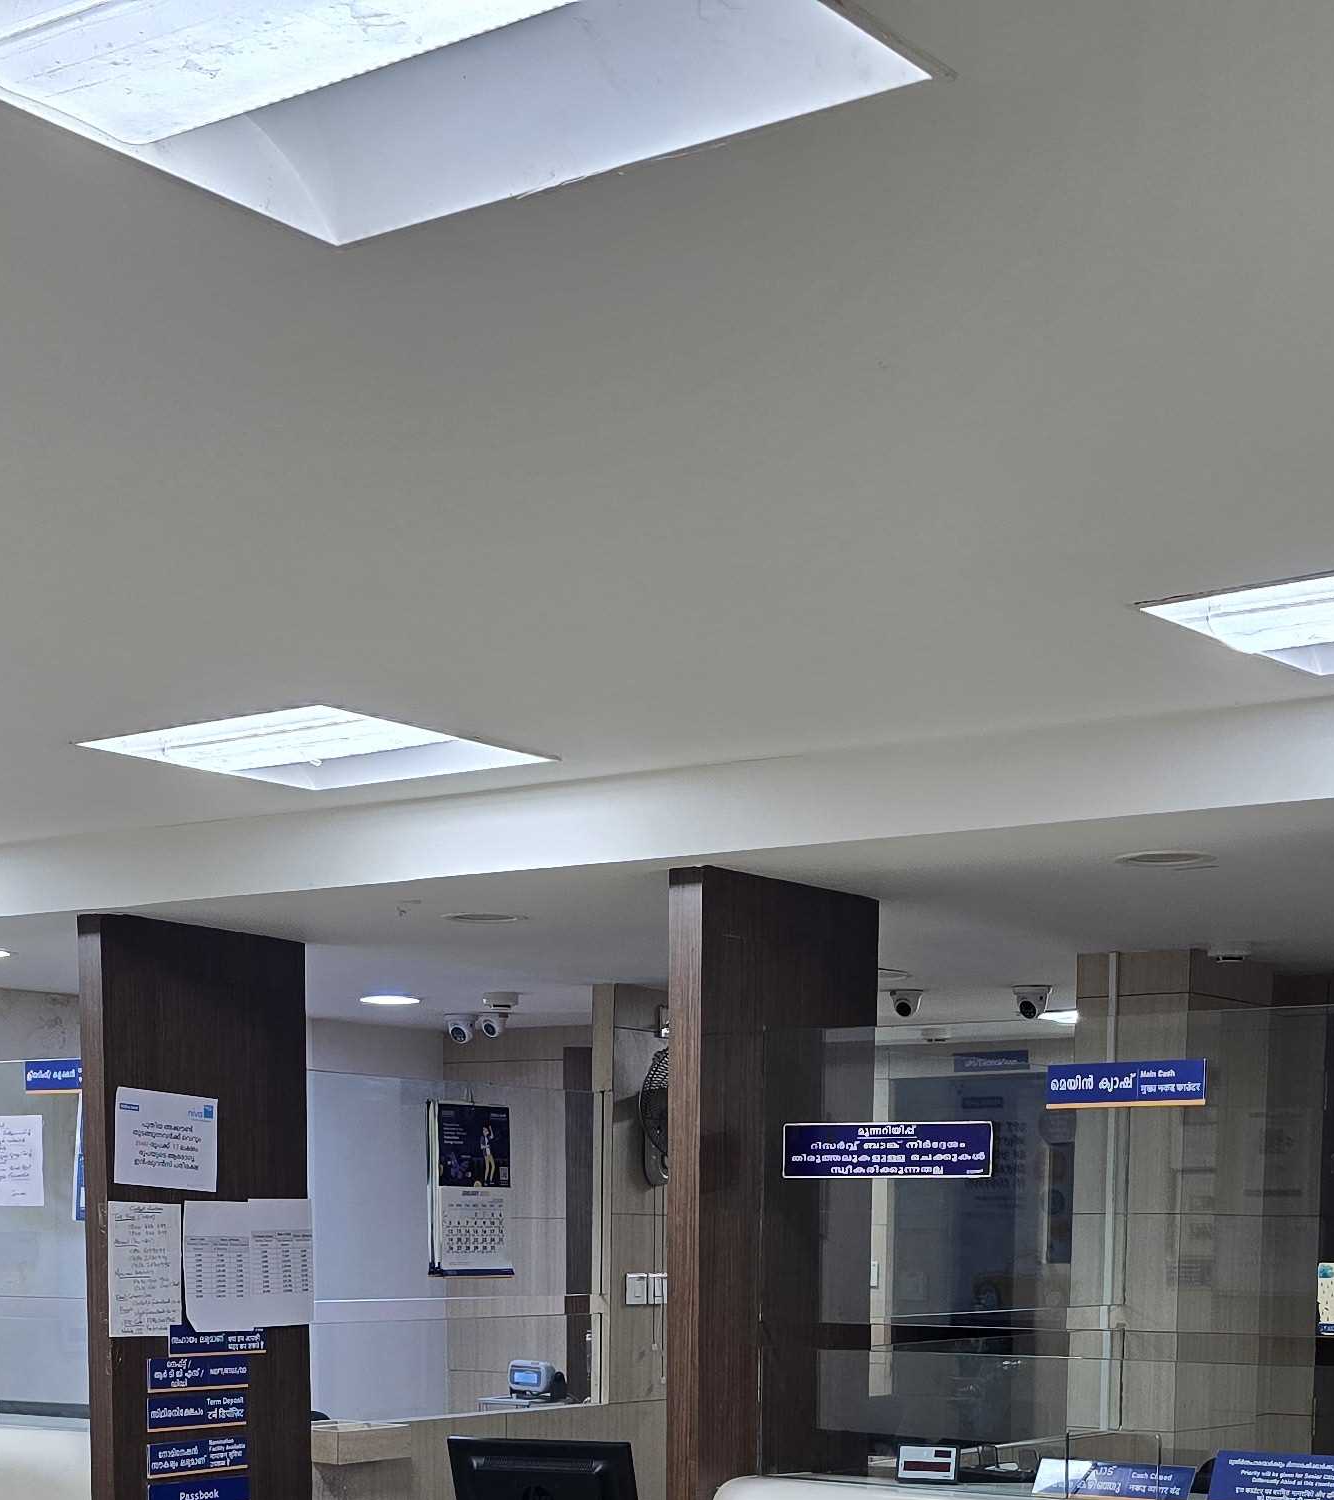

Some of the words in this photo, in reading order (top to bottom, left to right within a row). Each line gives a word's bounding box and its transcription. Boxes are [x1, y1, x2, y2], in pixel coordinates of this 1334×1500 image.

[1140, 1070, 1157, 1078] Main
[1157, 1069, 1176, 1078] Cash
[1050, 1074, 1094, 1091] മെയിൻ
[1098, 1072, 1137, 1093] ക്യാഷ്
[206, 1398, 222, 1406] Term
[222, 1396, 244, 1405] Deposit
[1131, 1471, 1149, 1480] Cash
[1240, 1469, 1261, 1477] Priority
